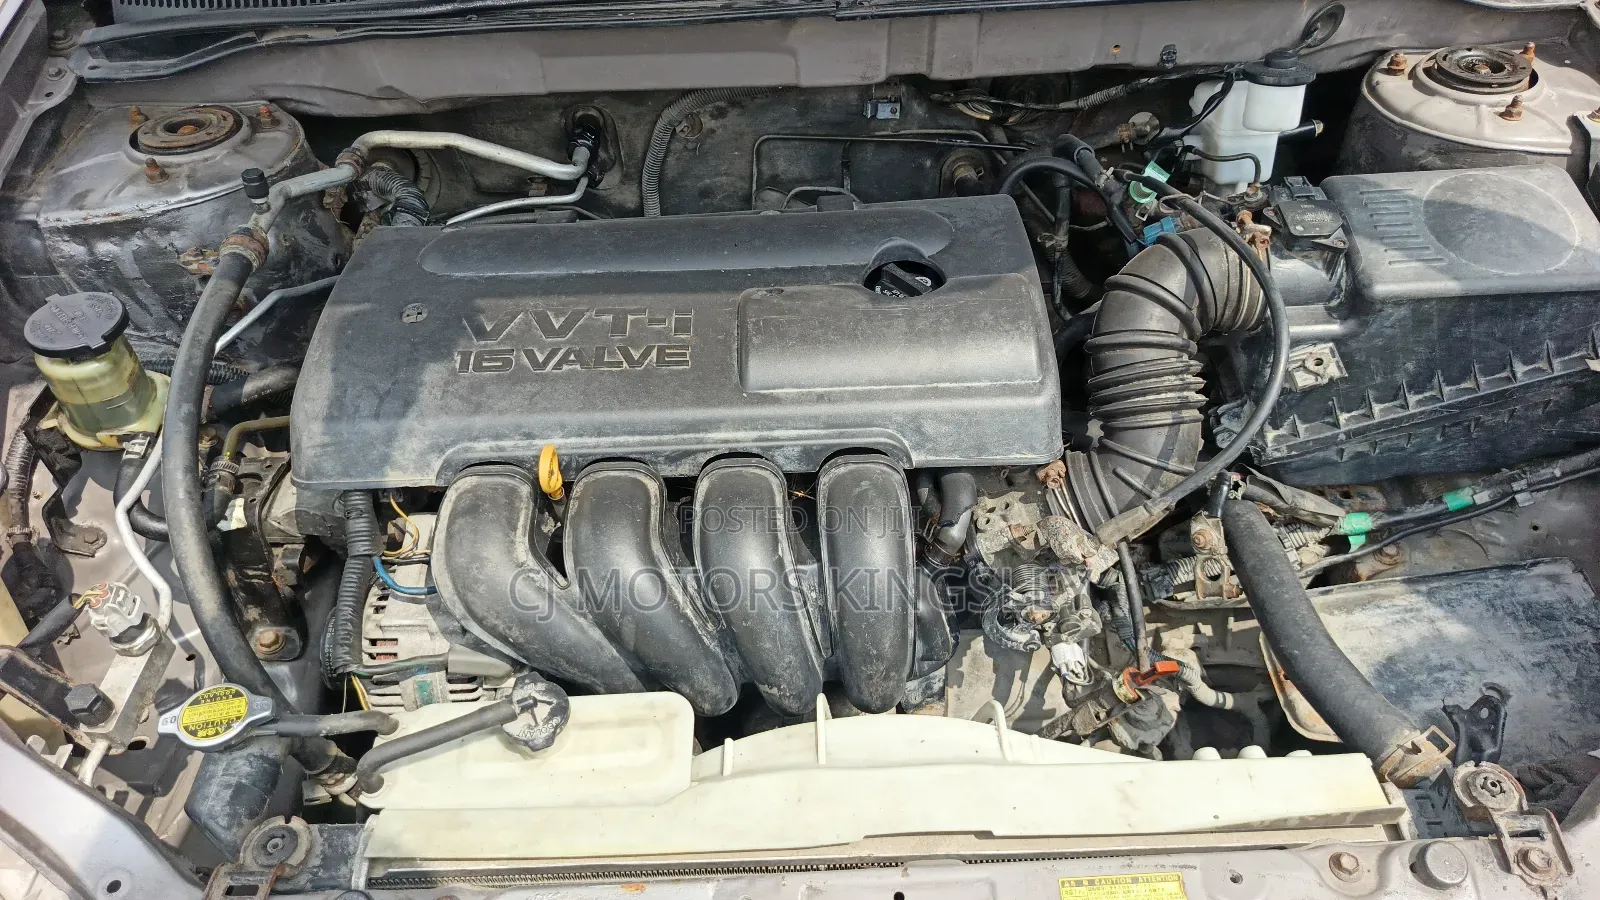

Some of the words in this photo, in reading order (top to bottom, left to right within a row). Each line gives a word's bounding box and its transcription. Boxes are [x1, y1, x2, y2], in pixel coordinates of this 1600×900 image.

[456, 348, 515, 374] 16
[521, 344, 691, 372] VALVE
[1094, 877, 1132, 886] CAUTION
[1138, 874, 1179, 883] ATTENTION
